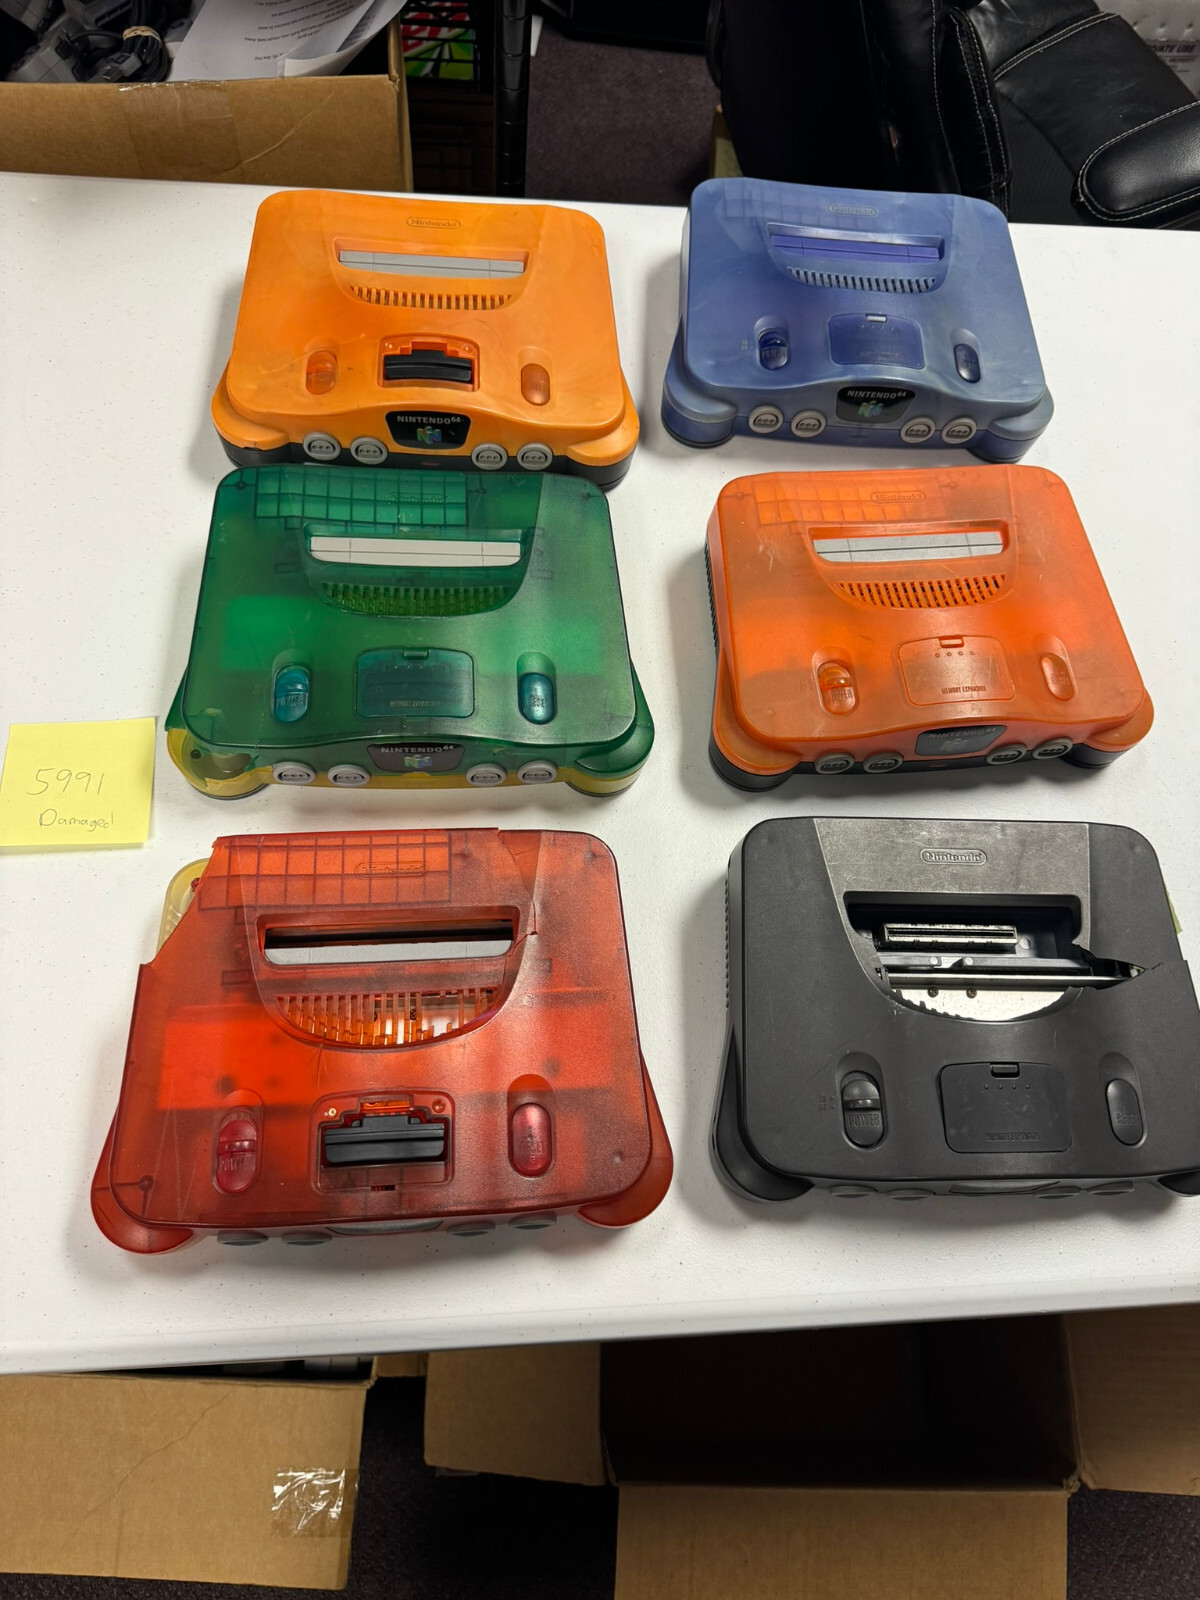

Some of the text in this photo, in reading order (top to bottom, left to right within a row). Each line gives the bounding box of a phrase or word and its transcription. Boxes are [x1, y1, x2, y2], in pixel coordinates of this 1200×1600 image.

[846, 390, 897, 399] NINTENDO
[396, 415, 451, 425] NINTENDO
[380, 746, 443, 754] NINTENDO
[26, 767, 105, 796] 5991
[39, 808, 114, 832] Damaged
[926, 851, 983, 862] Nintendo
[847, 1113, 881, 1127] POWER
